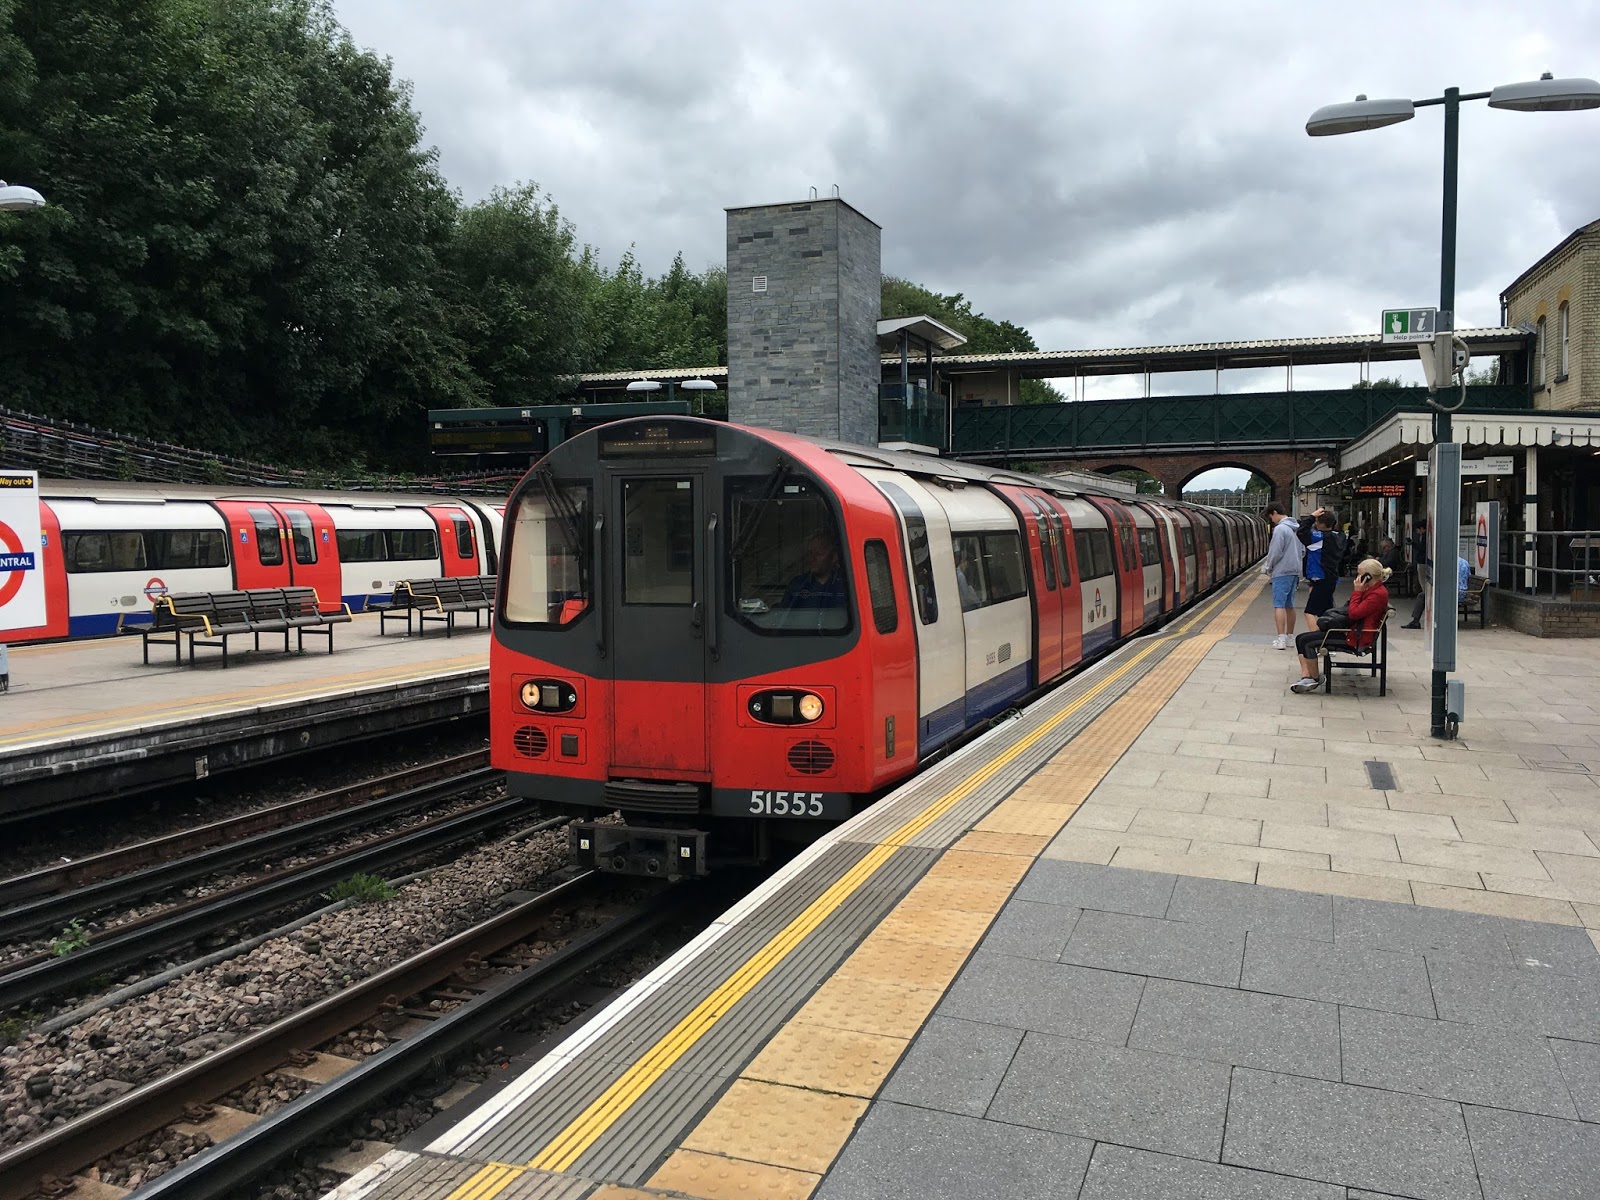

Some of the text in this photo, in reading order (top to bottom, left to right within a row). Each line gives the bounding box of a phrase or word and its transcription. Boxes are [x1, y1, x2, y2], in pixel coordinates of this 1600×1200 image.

[0, 478, 12, 486] Way
[0, 557, 32, 567] NTRAL
[749, 790, 824, 816] 51555
